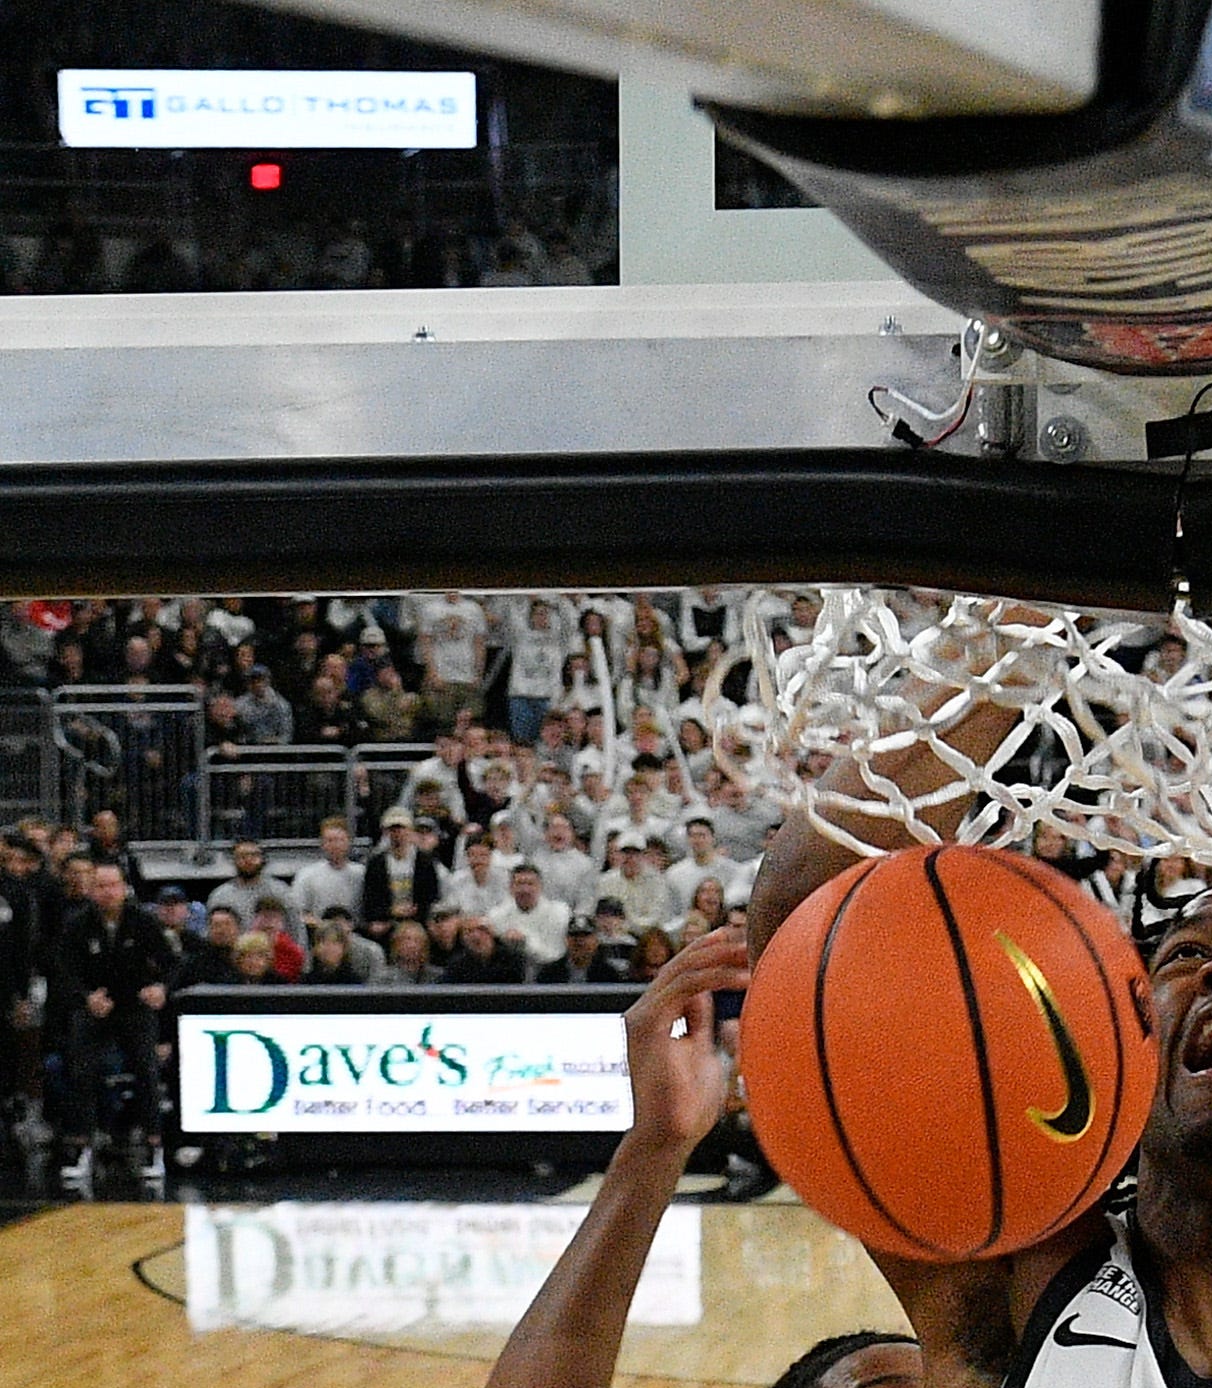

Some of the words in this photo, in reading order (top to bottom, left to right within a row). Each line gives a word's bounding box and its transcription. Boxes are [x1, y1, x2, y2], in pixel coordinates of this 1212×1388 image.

[165, 96, 285, 114] GALLO
[304, 96, 459, 115] THOMAS
[203, 1024, 468, 1113] Dave's
